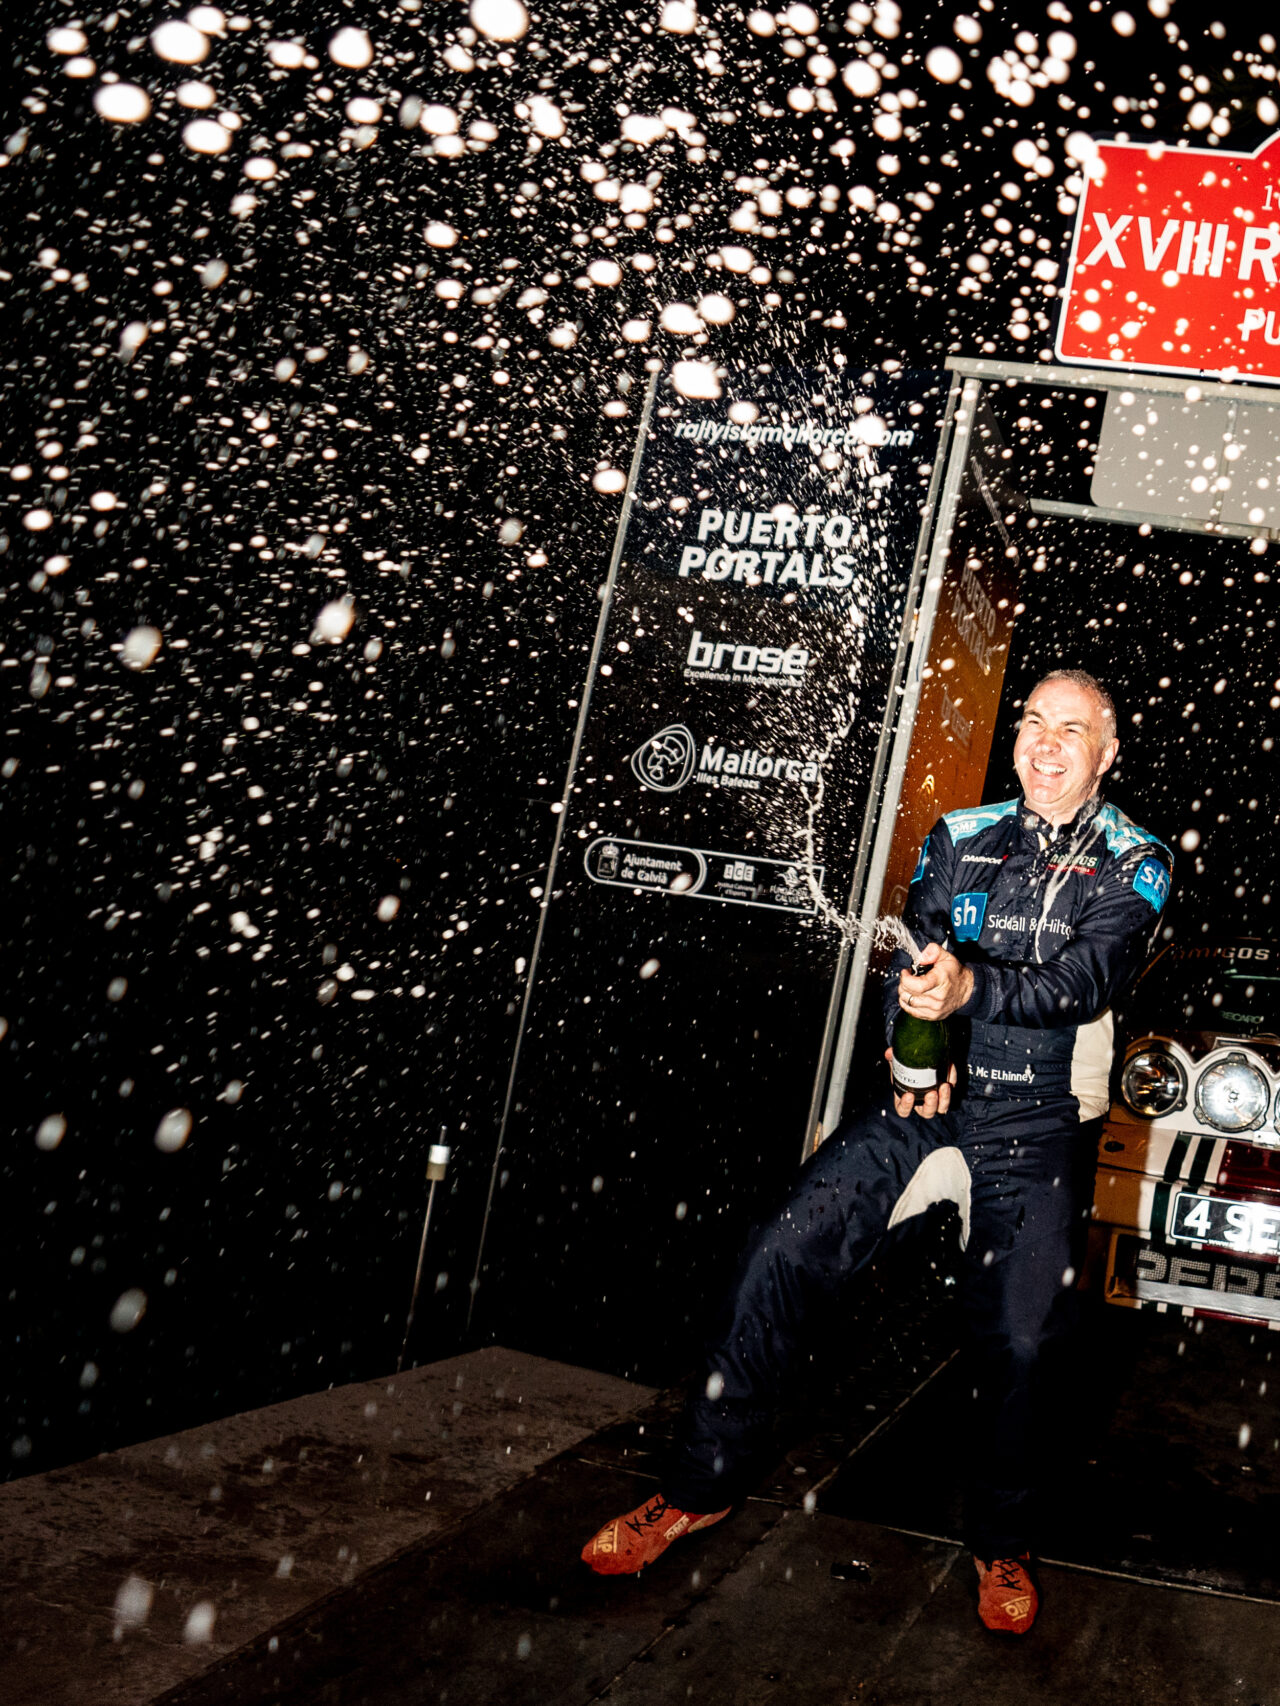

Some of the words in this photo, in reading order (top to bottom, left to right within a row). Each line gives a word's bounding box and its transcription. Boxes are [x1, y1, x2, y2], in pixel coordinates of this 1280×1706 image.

[1083, 212, 1229, 278] XVIII
[698, 508, 852, 548] PUERTO
[678, 545, 855, 588] PORTALS
[687, 630, 810, 676] brose
[699, 745, 819, 783] Mallorca
[950, 821, 977, 837] OMP
[620, 867, 633, 879] de
[622, 853, 682, 872] Ajuntament
[1140, 865, 1167, 898] sh
[953, 898, 977, 927] sh
[987, 914, 1026, 932] Siddall
[1029, 918, 1038, 931] &
[976, 1066, 988, 1078] Mc
[1184, 1200, 1212, 1238] 4
